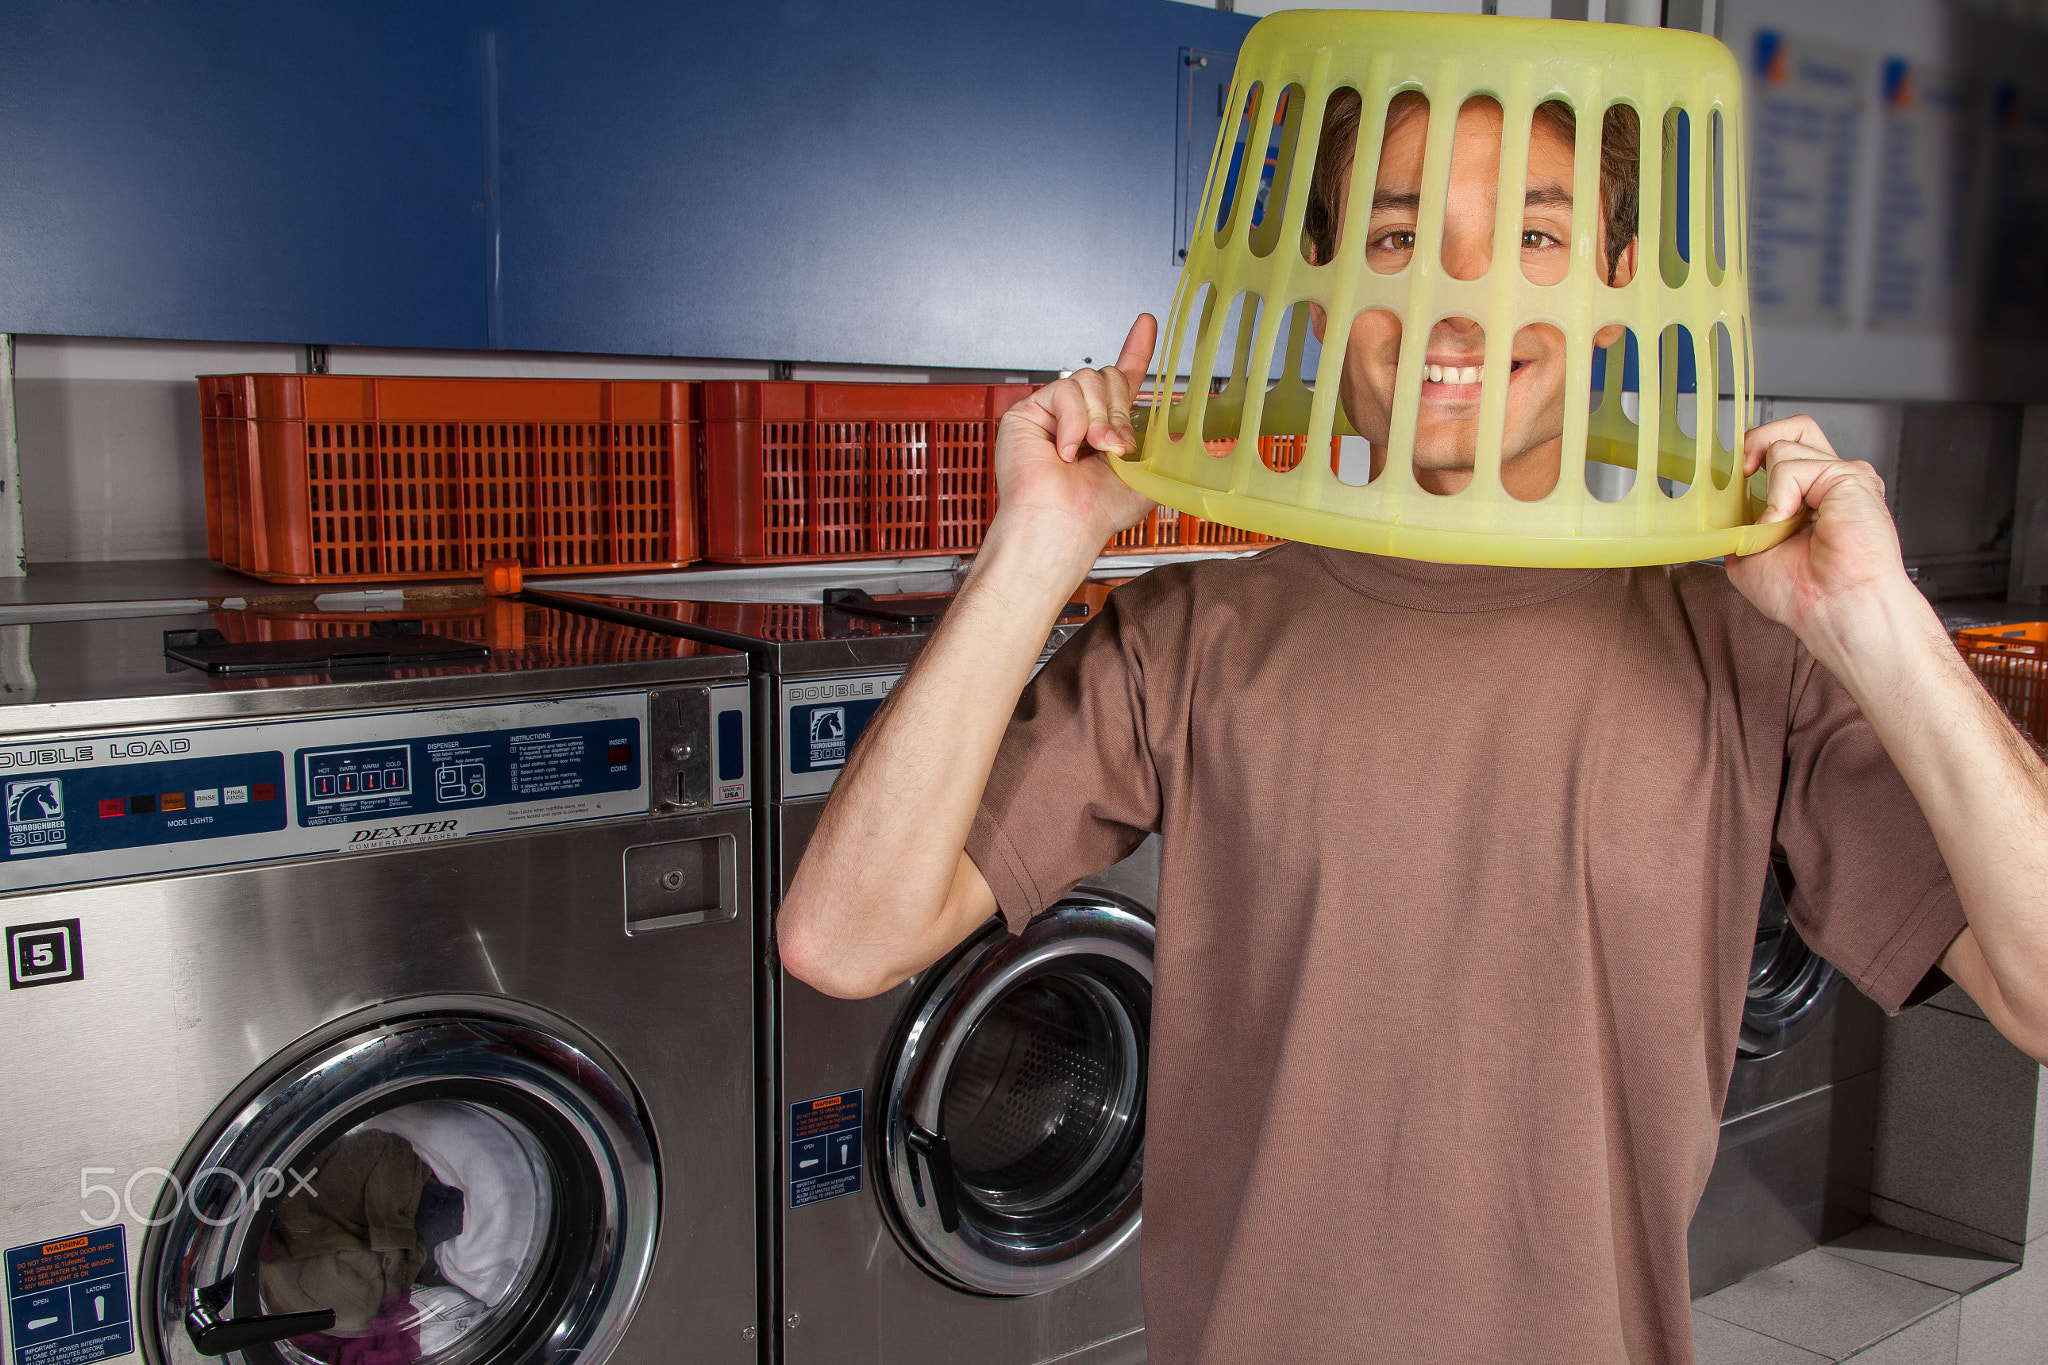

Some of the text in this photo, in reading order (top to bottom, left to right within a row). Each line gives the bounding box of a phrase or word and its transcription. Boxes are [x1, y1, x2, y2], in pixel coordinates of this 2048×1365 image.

[789, 683, 873, 701] DOUBLE
[510, 732, 550, 742] INSTRUCTIONS
[110, 738, 190, 758] LOAD
[428, 742, 459, 750] DISPENSER
[810, 740, 845, 750] THOROUGHBRED
[810, 747, 845, 760] 300
[8, 820, 65, 833] THOROUGHBRED
[167, 816, 214, 827] MODE LIGHTS
[10, 828, 66, 846] 300
[349, 820, 458, 843] DEXTER
[349, 833, 458, 850] COMMERCIAL WASHER
[32, 943, 53, 966] 5
[814, 1098, 840, 1108] WARNING
[45, 1239, 86, 1252] WARNING
[50, 1268, 70, 1276] WATER
[91, 1257, 114, 1267] WINDOW
[61, 1257, 86, 1267] TURNING
[86, 1283, 111, 1293] LATCHED
[33, 1298, 49, 1306] OPEN
[33, 1351, 48, 1359] CASE
[59, 1344, 79, 1353] POWER
[56, 1350, 80, 1360] MINUTES
[82, 1344, 104, 1354] BEFORE
[72, 1354, 87, 1362] OPEN
